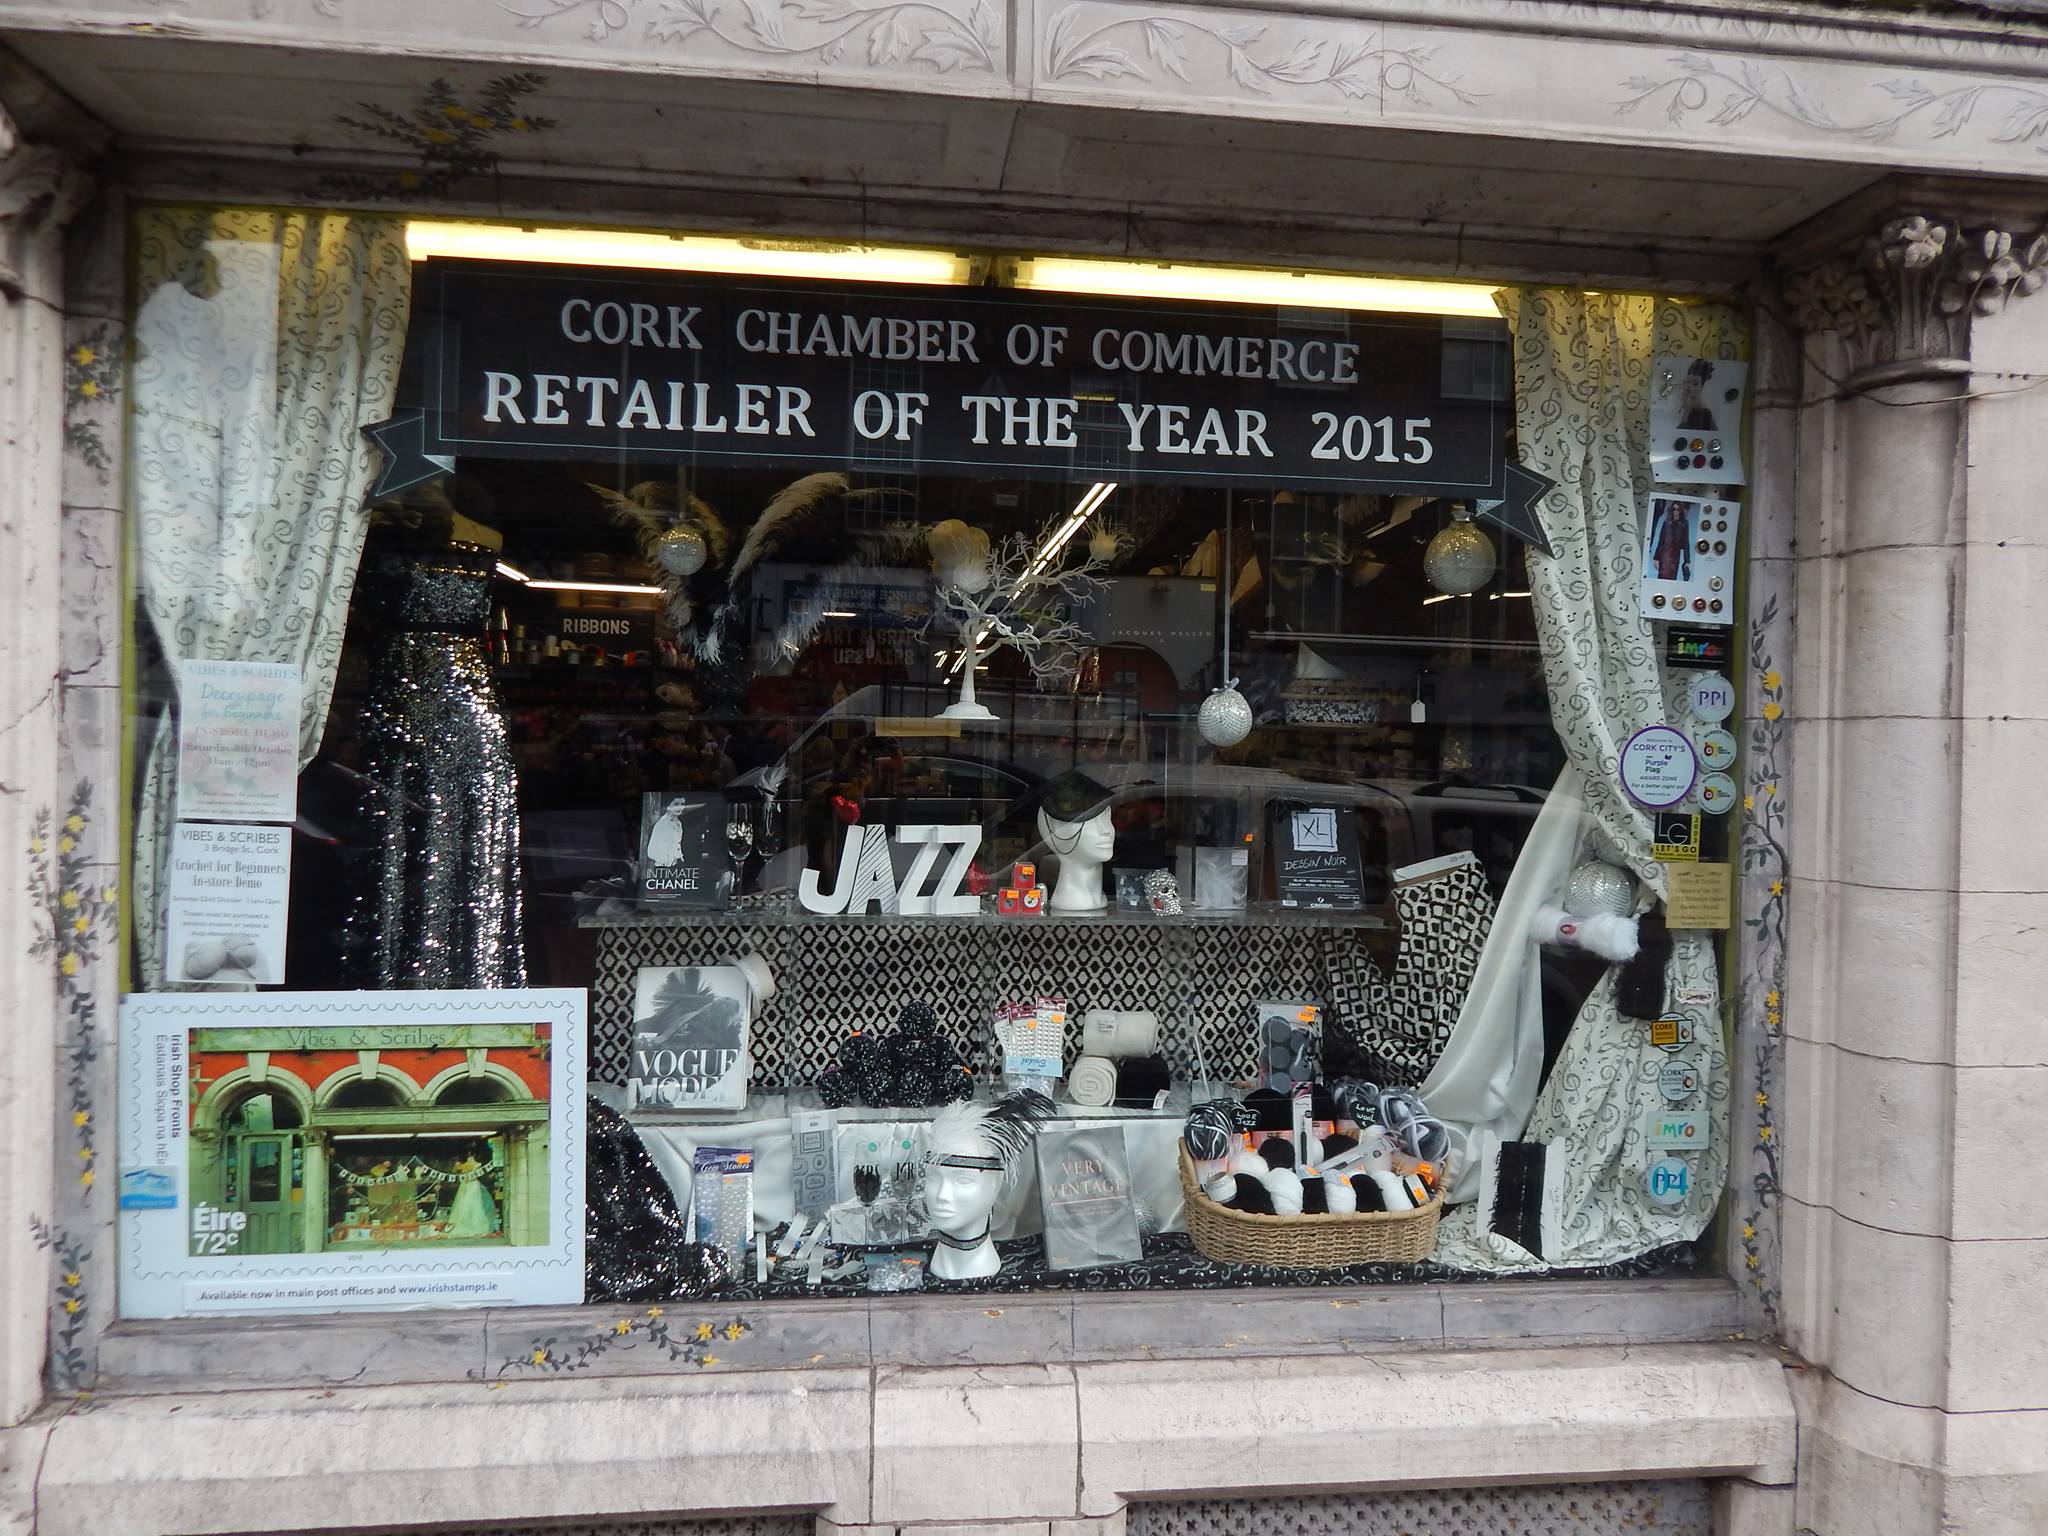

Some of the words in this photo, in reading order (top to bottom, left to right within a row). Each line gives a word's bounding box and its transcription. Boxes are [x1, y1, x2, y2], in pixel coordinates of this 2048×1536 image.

[561, 299, 704, 350] CORK
[735, 309, 979, 364] CHAMBER
[1007, 324, 1069, 367] OF
[1092, 328, 1361, 383] COMMERCE
[483, 371, 816, 437] RETAILER
[852, 390, 930, 441] OF
[961, 396, 1079, 447] THE
[1117, 402, 1274, 457] YEAR
[1310, 411, 1434, 464] 2015
[563, 618, 630, 635] RIBBONS
[1699, 690, 1726, 706] PPI
[1659, 744, 1686, 752] CITY'S
[1645, 766, 1661, 774] Flag
[182, 830, 214, 841] VIBES
[217, 831, 226, 841] &
[230, 831, 281, 843] SCRIBES
[1303, 816, 1329, 840] XL
[216, 860, 232, 872] for
[235, 860, 288, 876] Beginners
[800, 823, 983, 915] JAZZ
[1284, 856, 1322, 870] DESSIN
[1324, 855, 1348, 866] NOIR
[194, 874, 232, 887] In-store
[236, 876, 262, 888] Demo
[646, 867, 700, 879] INTIMATE
[645, 878, 700, 890] CHANEL
[287, 1029, 337, 1046] Vibes
[350, 1029, 368, 1046] &
[380, 1028, 446, 1045] Scribes
[170, 1034, 182, 1061] Irish
[635, 1049, 738, 1077] VOGUE
[168, 1065, 183, 1098] Shop
[170, 1101, 183, 1138] Fronts
[1655, 1119, 1695, 1138] imro
[157, 1125, 166, 1140] na
[1062, 1159, 1105, 1176] VERY
[194, 1201, 247, 1232] Éire
[193, 1232, 239, 1255] 72c
[200, 1289, 248, 1301] Available
[250, 1290, 273, 1299] now
[275, 1289, 286, 1298] in
[288, 1288, 314, 1298] main
[316, 1286, 339, 1299] post
[341, 1284, 375, 1296] offices
[377, 1284, 396, 1295] and
[398, 1281, 498, 1295] www.irishstamps.ie
